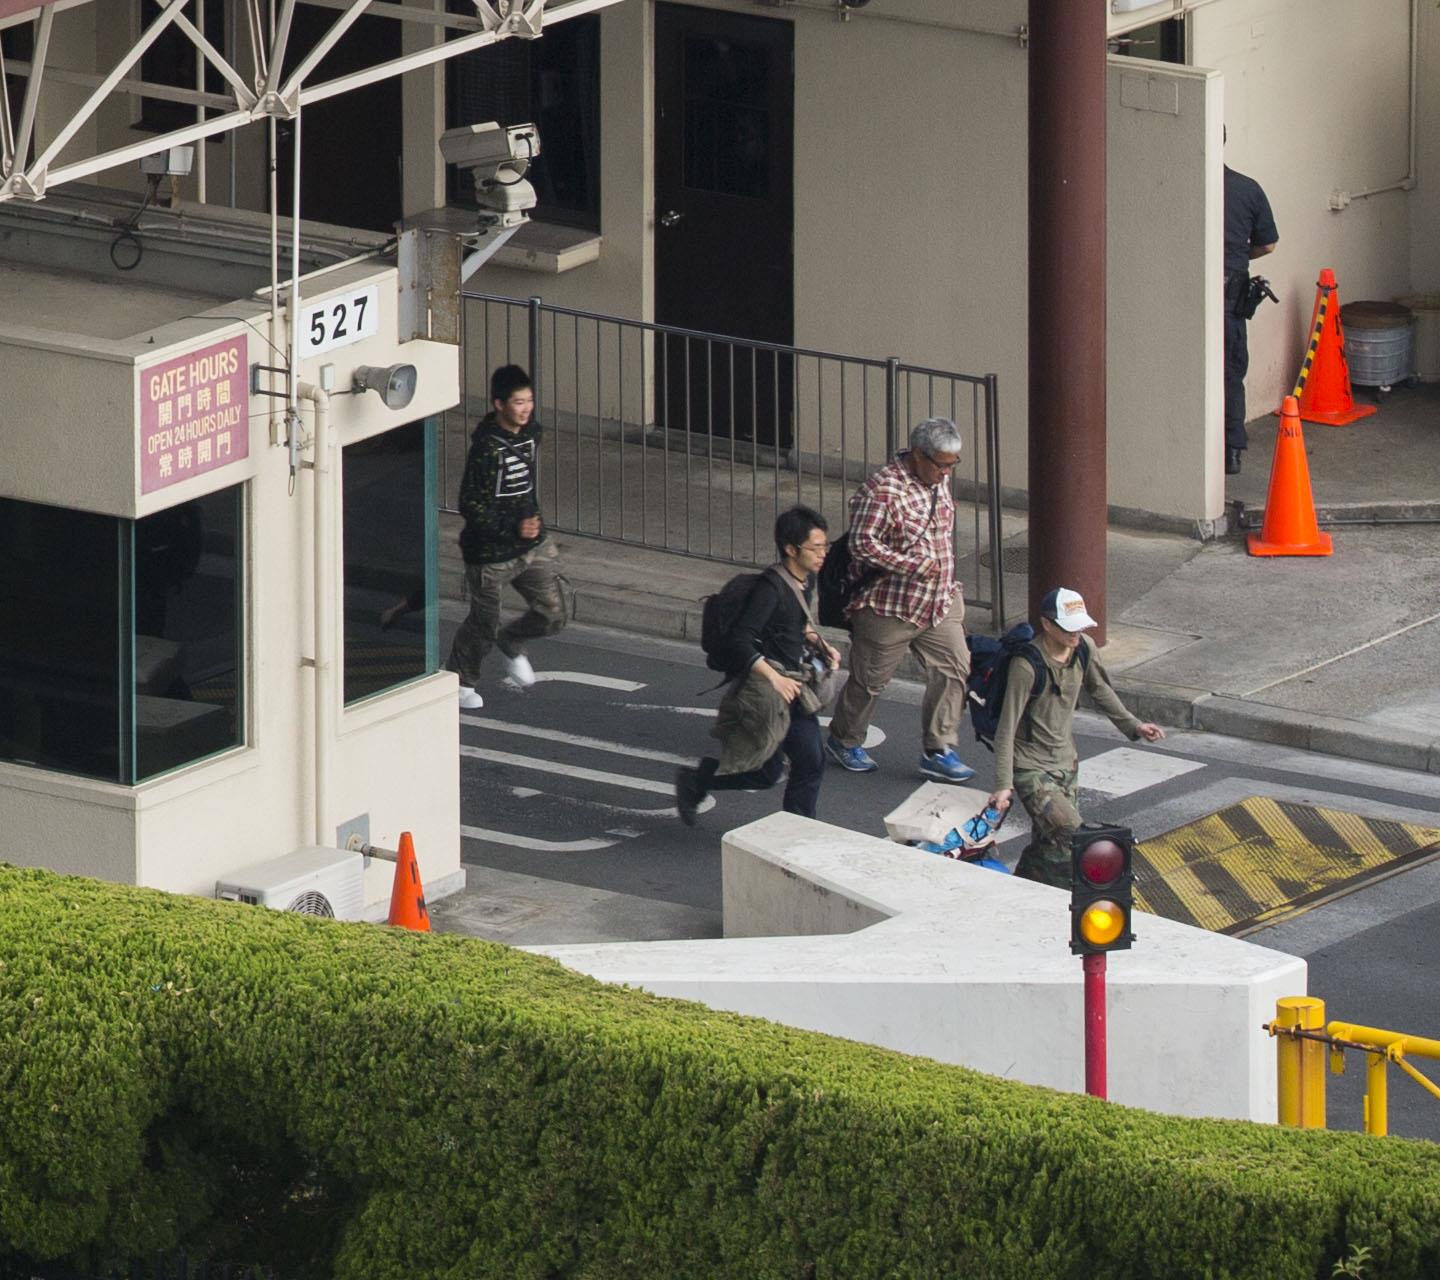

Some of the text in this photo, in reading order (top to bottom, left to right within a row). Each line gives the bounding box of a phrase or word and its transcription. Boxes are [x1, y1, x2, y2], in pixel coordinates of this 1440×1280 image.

[310, 296, 368, 346] 527
[150, 347, 238, 401] GATE HOURS
[158, 379, 231, 428] 開門時間
[148, 404, 241, 455] OPEN 24 HOURS DAILY
[159, 431, 231, 478] 常時開門
